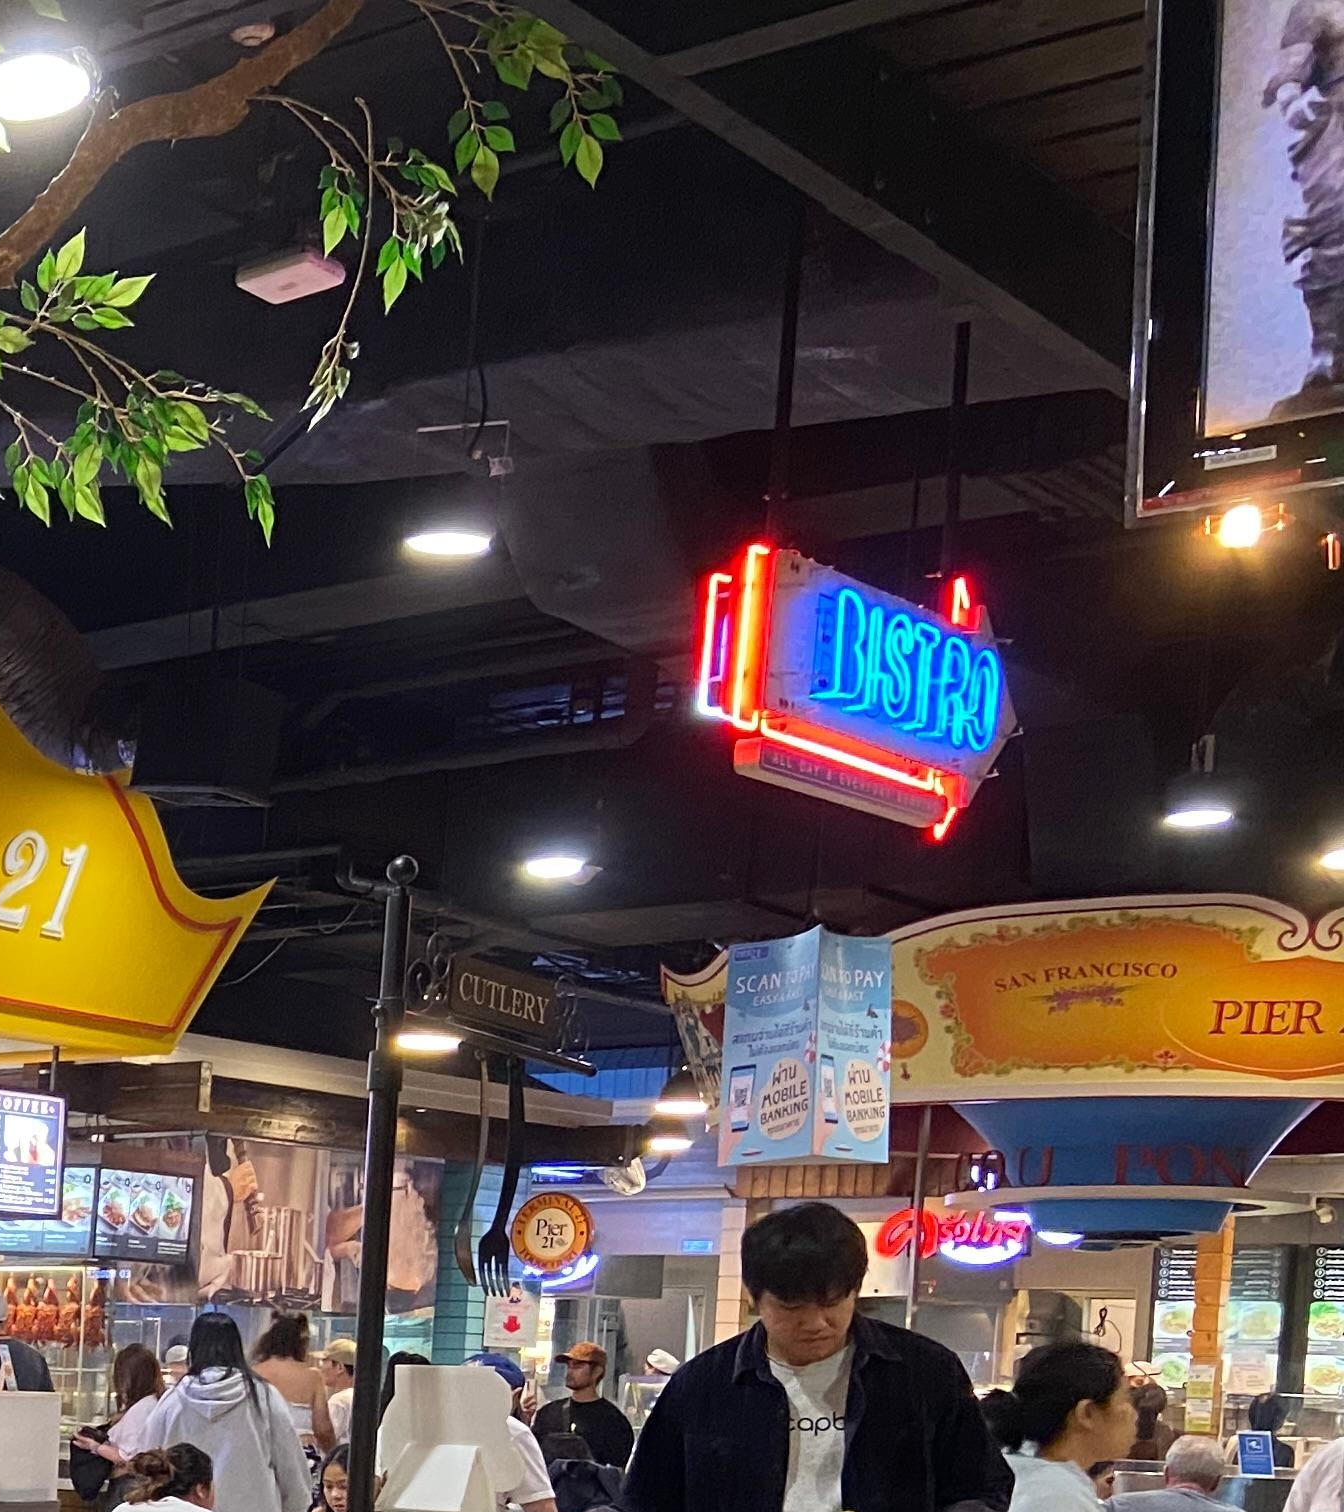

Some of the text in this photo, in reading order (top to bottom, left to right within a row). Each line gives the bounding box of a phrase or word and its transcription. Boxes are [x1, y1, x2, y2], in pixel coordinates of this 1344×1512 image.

[809, 588, 1001, 751] BISTRO
[735, 973, 782, 994] SCAN
[854, 969, 885, 988] PAY
[994, 961, 1178, 993] SAN FRANCISCO
[459, 972, 549, 1025] CUTLERY
[1208, 1000, 1324, 1036] PIER
[771, 1062, 798, 1087] ผ่าน
[848, 1063, 871, 1084] ผ่าน
[763, 1079, 808, 1107] MOBILE
[845, 1087, 883, 1105] MOBILE
[760, 1098, 809, 1125] BANKING
[846, 1106, 886, 1123] BANKING
[535, 1218, 569, 1236] Pier
[541, 1236, 554, 1249] 21
